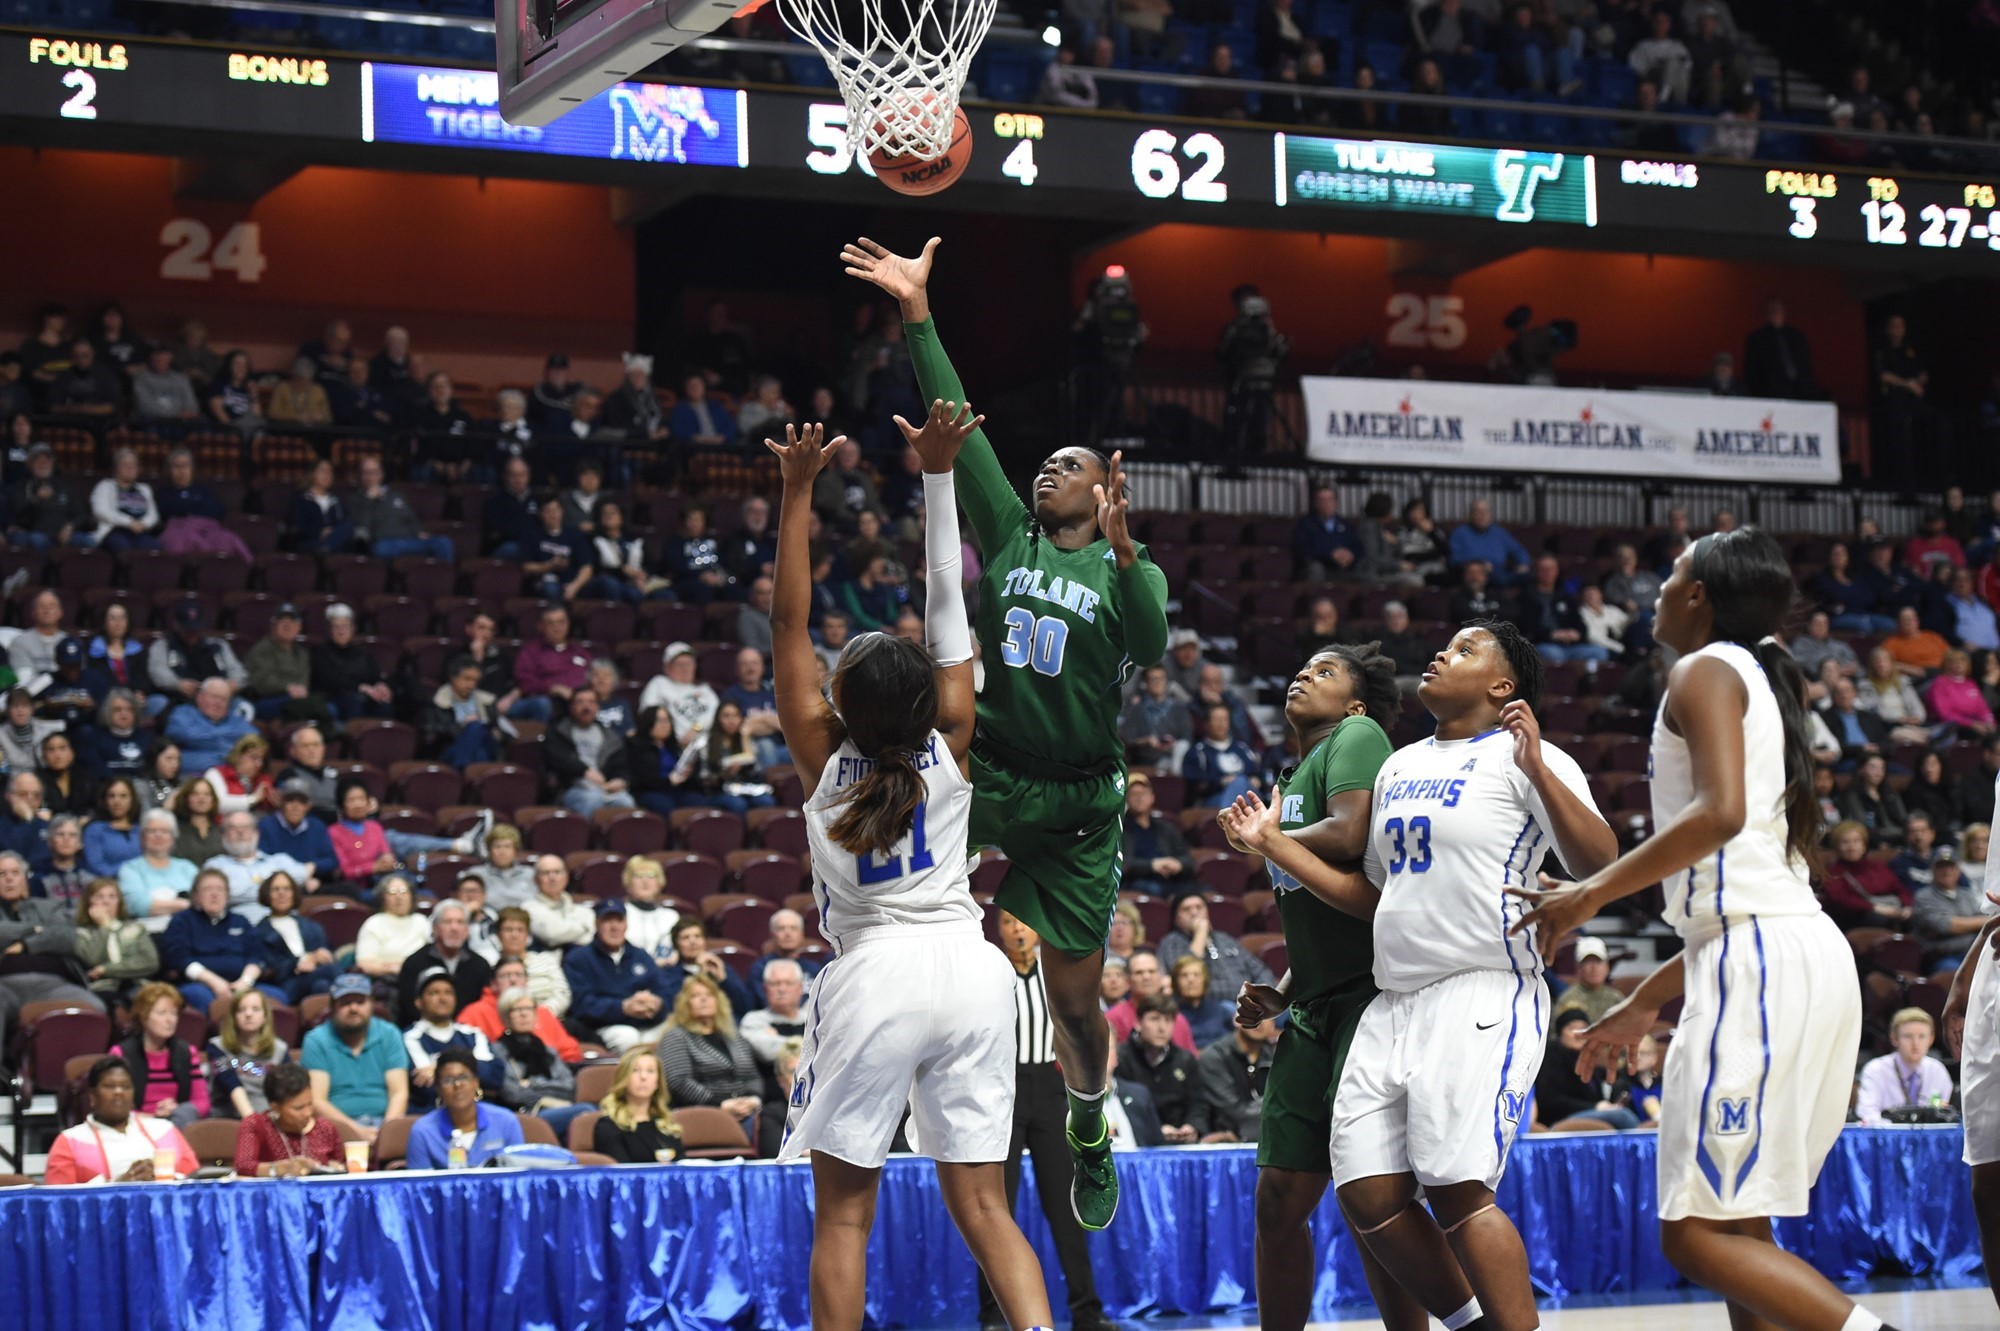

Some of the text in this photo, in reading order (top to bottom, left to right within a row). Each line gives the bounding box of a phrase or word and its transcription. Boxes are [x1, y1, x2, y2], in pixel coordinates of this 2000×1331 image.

[29, 38, 128, 71] FOULS
[228, 53, 329, 86] BONUS
[60, 69, 97, 119] 2
[417, 73, 499, 107] MEMP
[806, 103, 878, 178] 5
[901, 155, 953, 184] NCAA
[1002, 138, 1038, 186] 4
[1131, 129, 1227, 202] 62
[1333, 143, 1435, 176] TULANE
[1621, 160, 1698, 188] BONUS
[1295, 171, 1474, 206] GREEN WAVE
[1766, 169, 1996, 208] FOULS TO FG
[1789, 197, 1818, 239] 3
[1861, 200, 1907, 245] 12
[160, 218, 267, 282] 24
[1385, 293, 1467, 350] 25
[1327, 411, 1464, 442] AMERICAN
[1511, 419, 1644, 451] AMERICAN
[1695, 428, 1822, 459] AMERICAN
[1001, 567, 1100, 624] TULANE
[1001, 606, 1069, 678] 30
[1378, 778, 1466, 812] MEMPHIS
[1384, 815, 1432, 875] 33
[1717, 1098, 1750, 1135] M
